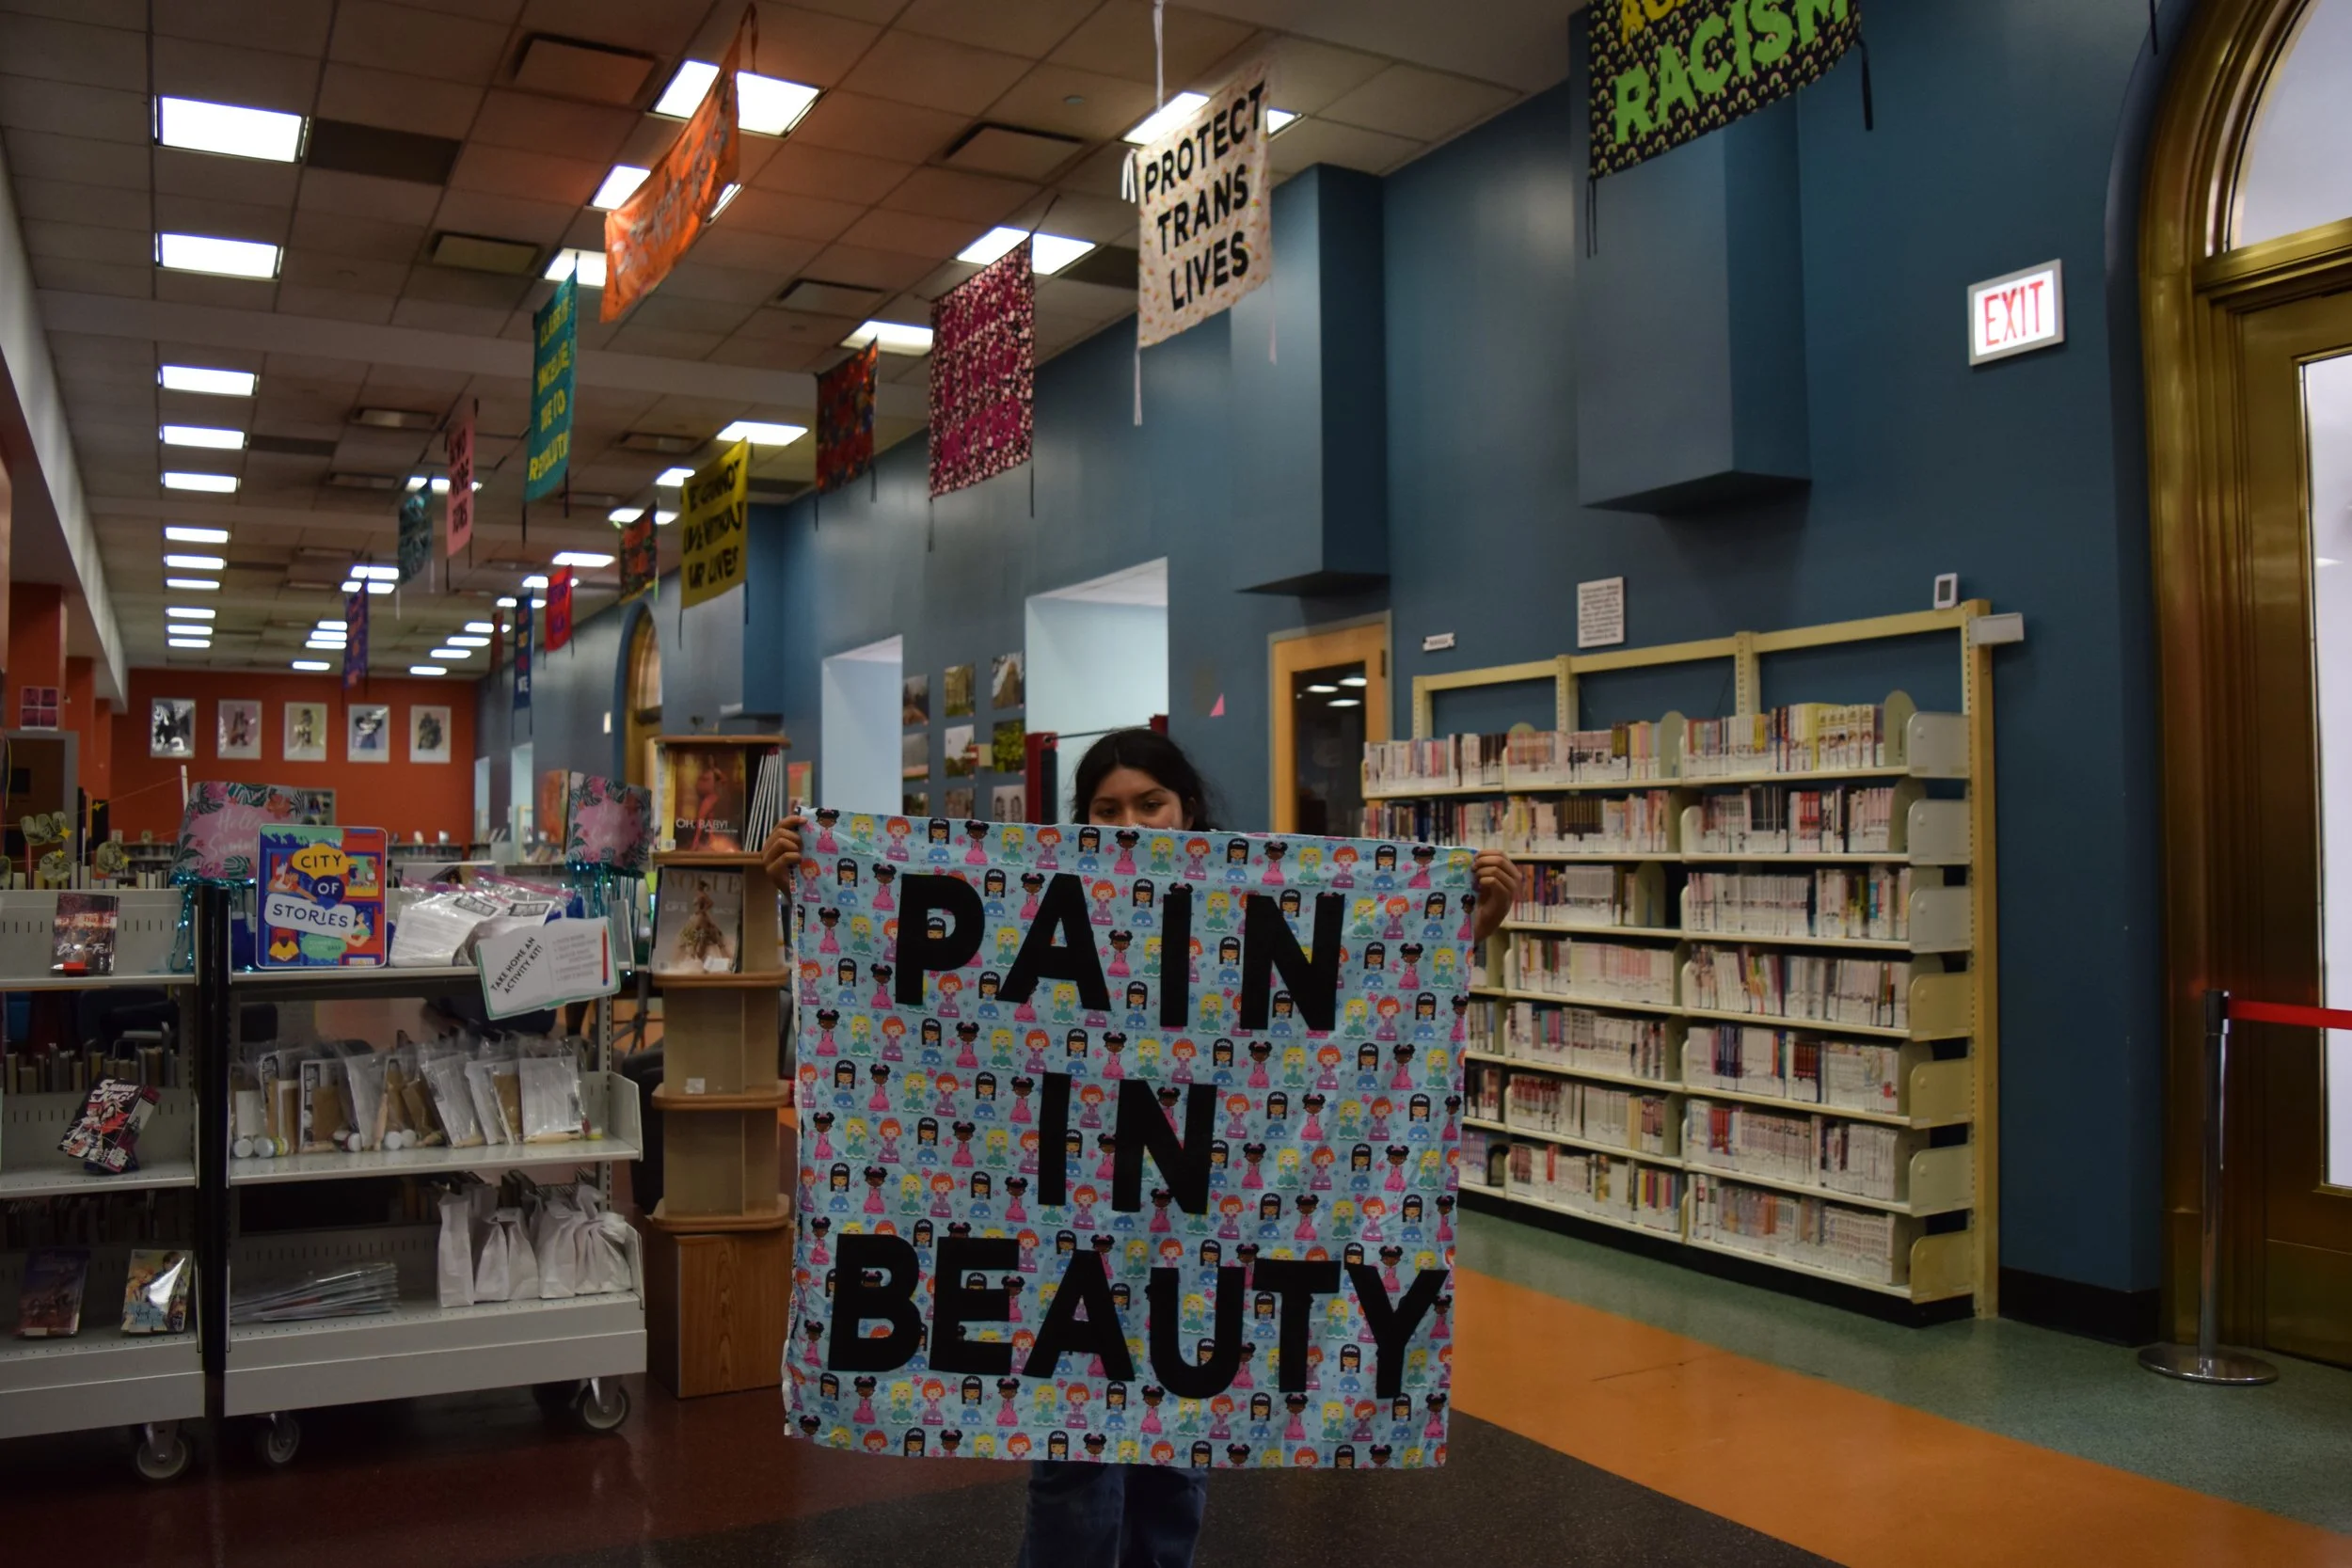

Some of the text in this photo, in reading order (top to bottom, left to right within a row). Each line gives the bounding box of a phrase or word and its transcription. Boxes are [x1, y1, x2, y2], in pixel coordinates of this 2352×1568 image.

[1614, 0, 1848, 145] RACISM
[1145, 80, 1265, 204] PROTECT
[1157, 164, 1248, 255] TRANS
[1170, 231, 1248, 311] LIVES
[1984, 280, 2044, 346] EXIT
[301, 855, 342, 868] CITY
[317, 882, 340, 895] OF
[273, 903, 348, 927] STORIES
[896, 872, 1345, 1032] PAIN
[490, 936, 536, 991] TAKE HOME AN
[503, 944, 544, 994] ACTIVITY KIT!
[1038, 1072, 1217, 1215] IN
[828, 1233, 1448, 1400] BEAUTY
